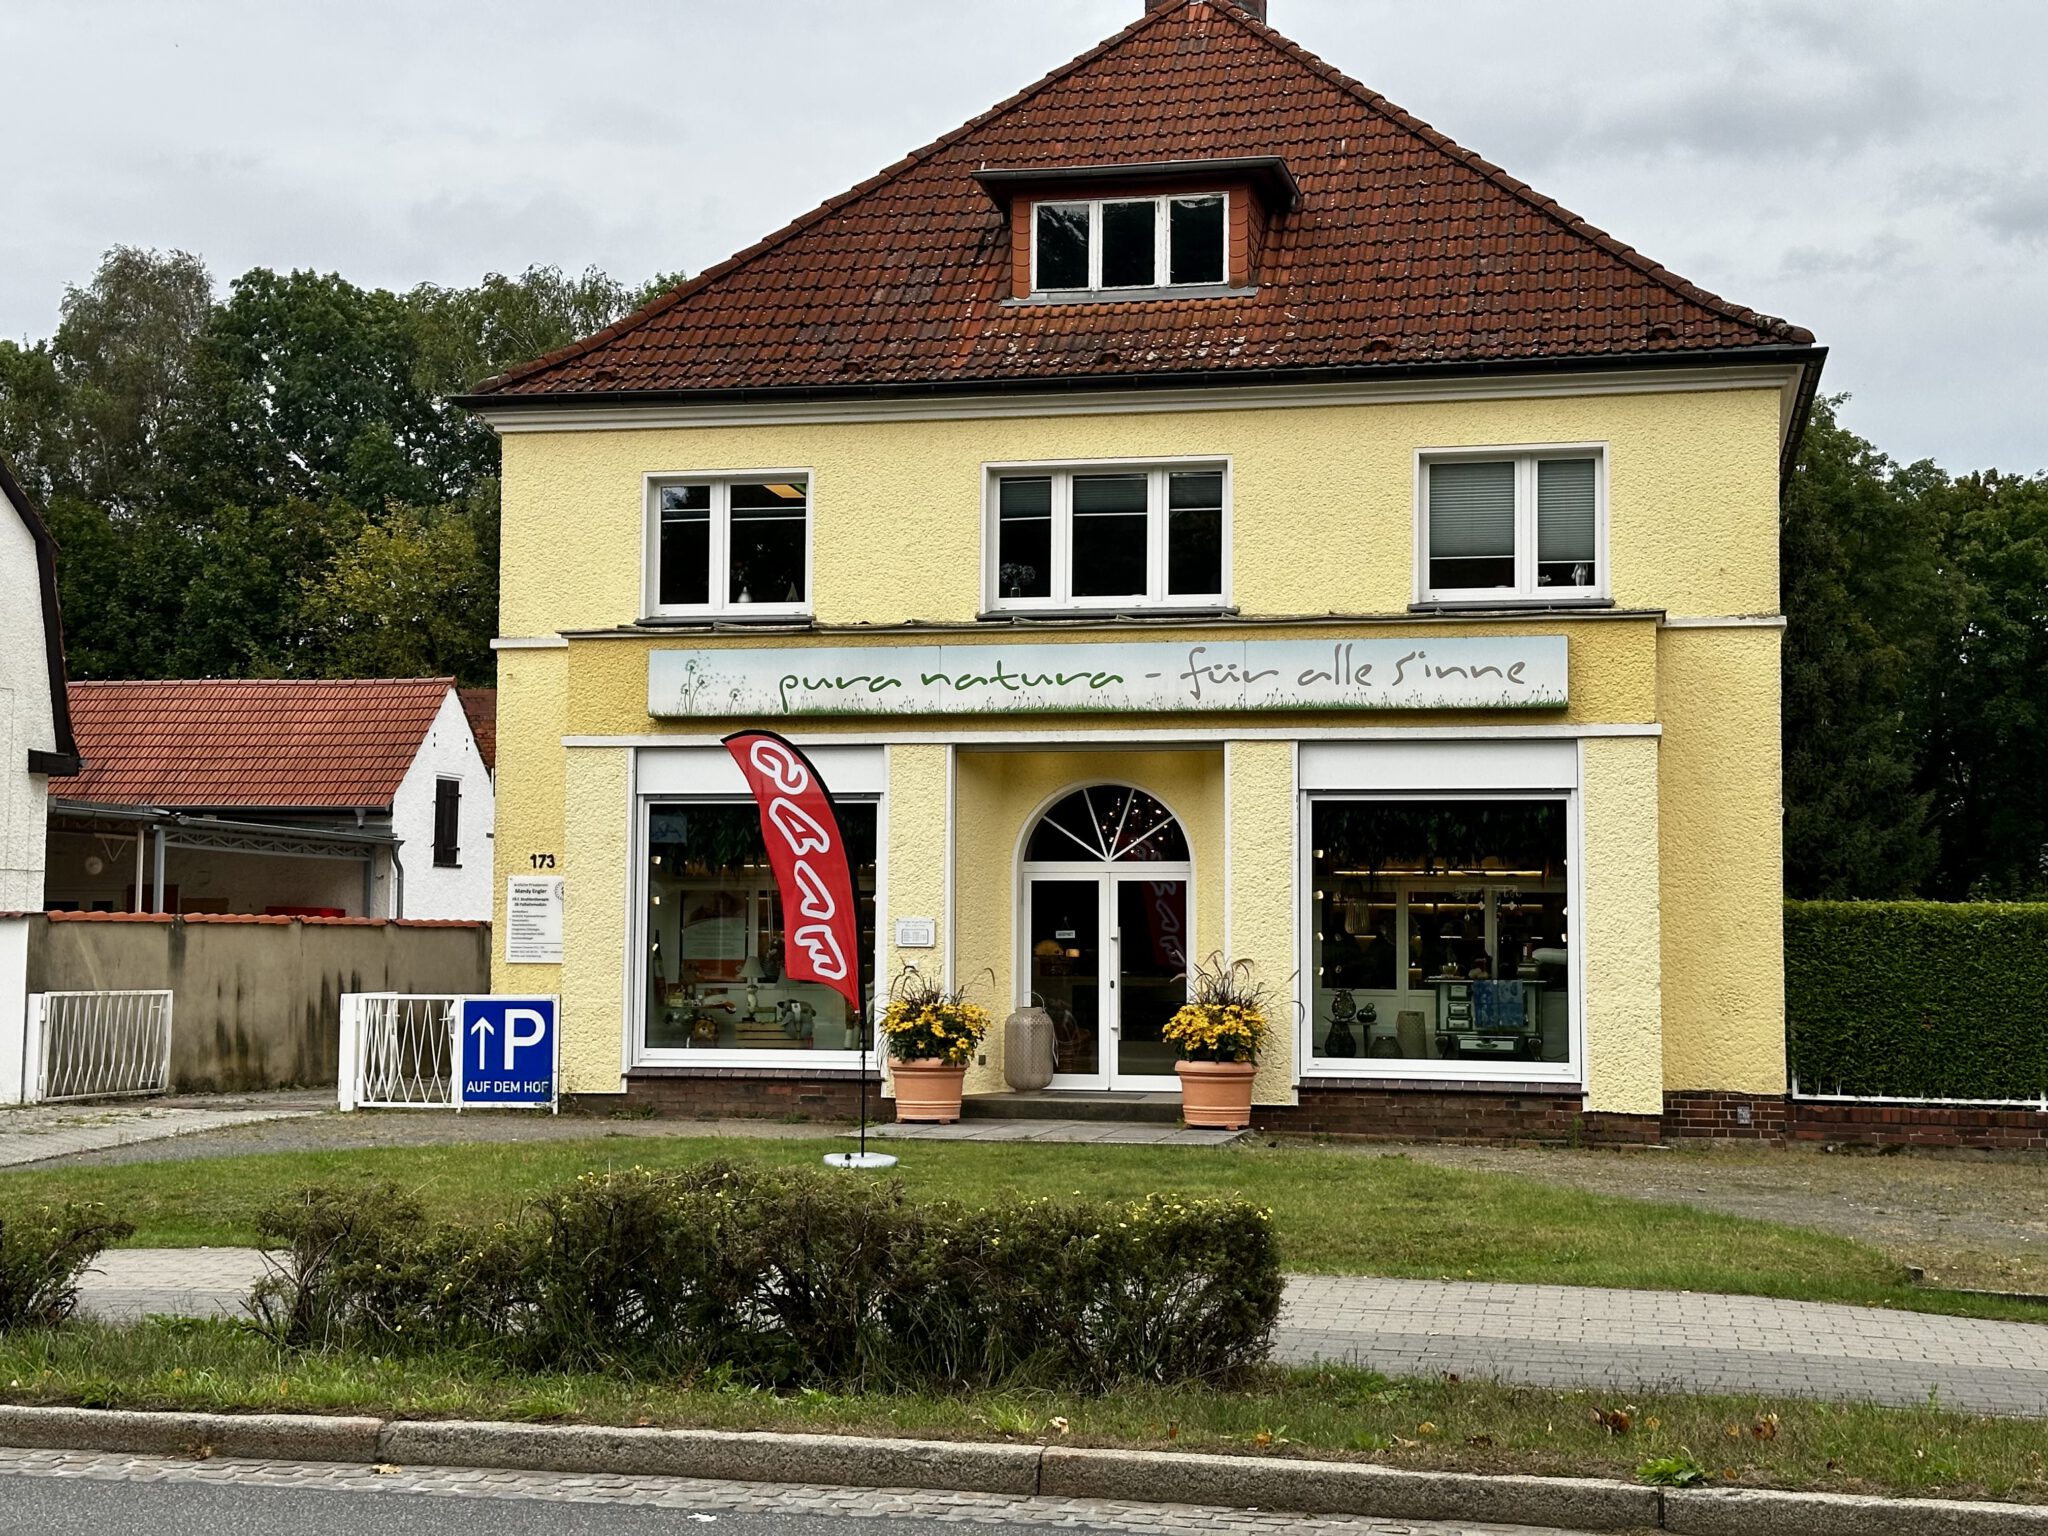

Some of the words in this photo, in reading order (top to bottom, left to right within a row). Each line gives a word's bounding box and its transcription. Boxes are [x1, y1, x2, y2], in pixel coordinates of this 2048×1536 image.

[779, 673, 902, 714] pura
[920, 660, 1124, 692] natura
[1180, 646, 1280, 700] für
[1297, 643, 1373, 687] alle
[1392, 651, 1526, 687] Sinne
[530, 853, 556, 869] 173
[504, 1008, 546, 1070] P
[466, 1080, 492, 1093] AUF
[494, 1080, 520, 1093] DEM
[524, 1080, 549, 1093] HOF
